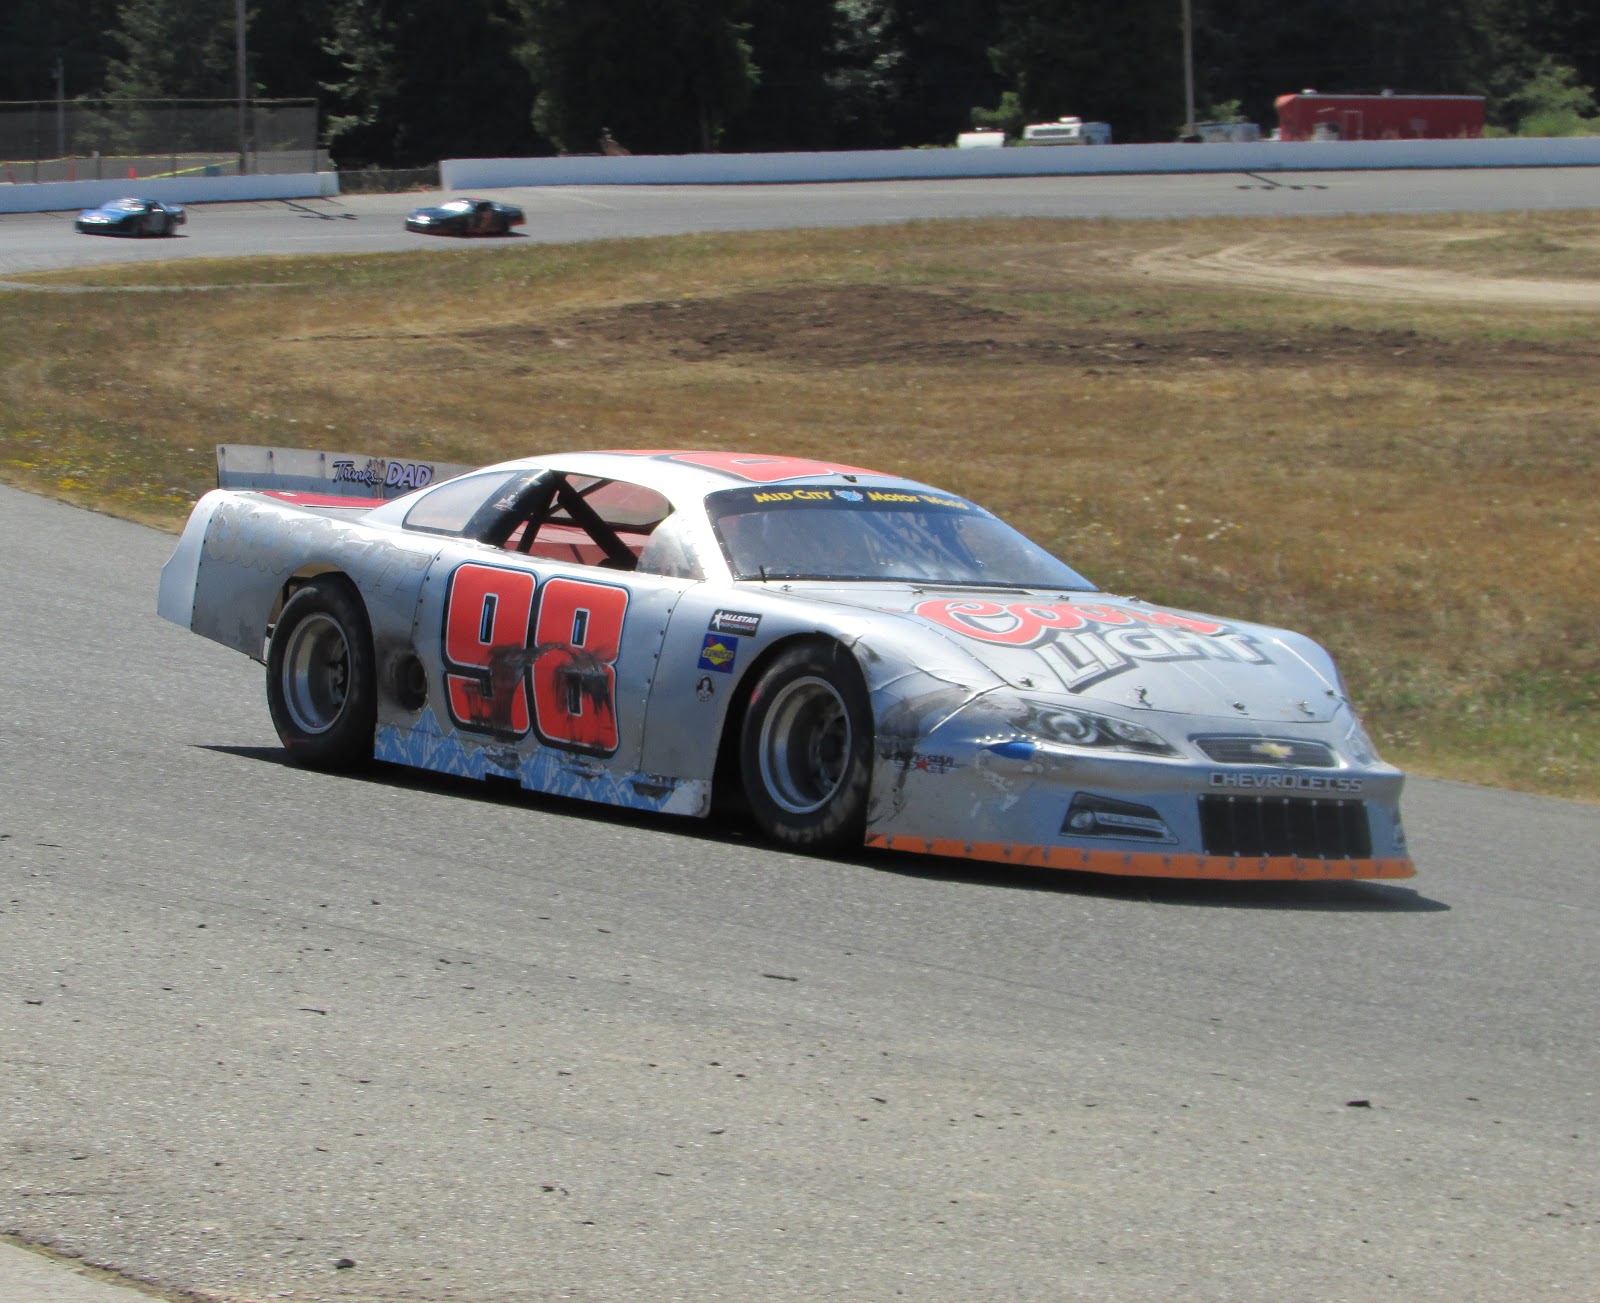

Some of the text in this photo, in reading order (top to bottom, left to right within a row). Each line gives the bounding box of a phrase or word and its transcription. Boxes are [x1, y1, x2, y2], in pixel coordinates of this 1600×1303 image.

[386, 462, 433, 488] DAD
[721, 614, 758, 624] ALLSTAR
[441, 559, 632, 759] 98
[1034, 627, 1277, 694] LIGHT
[1209, 772, 1334, 791] CHEVROLET
